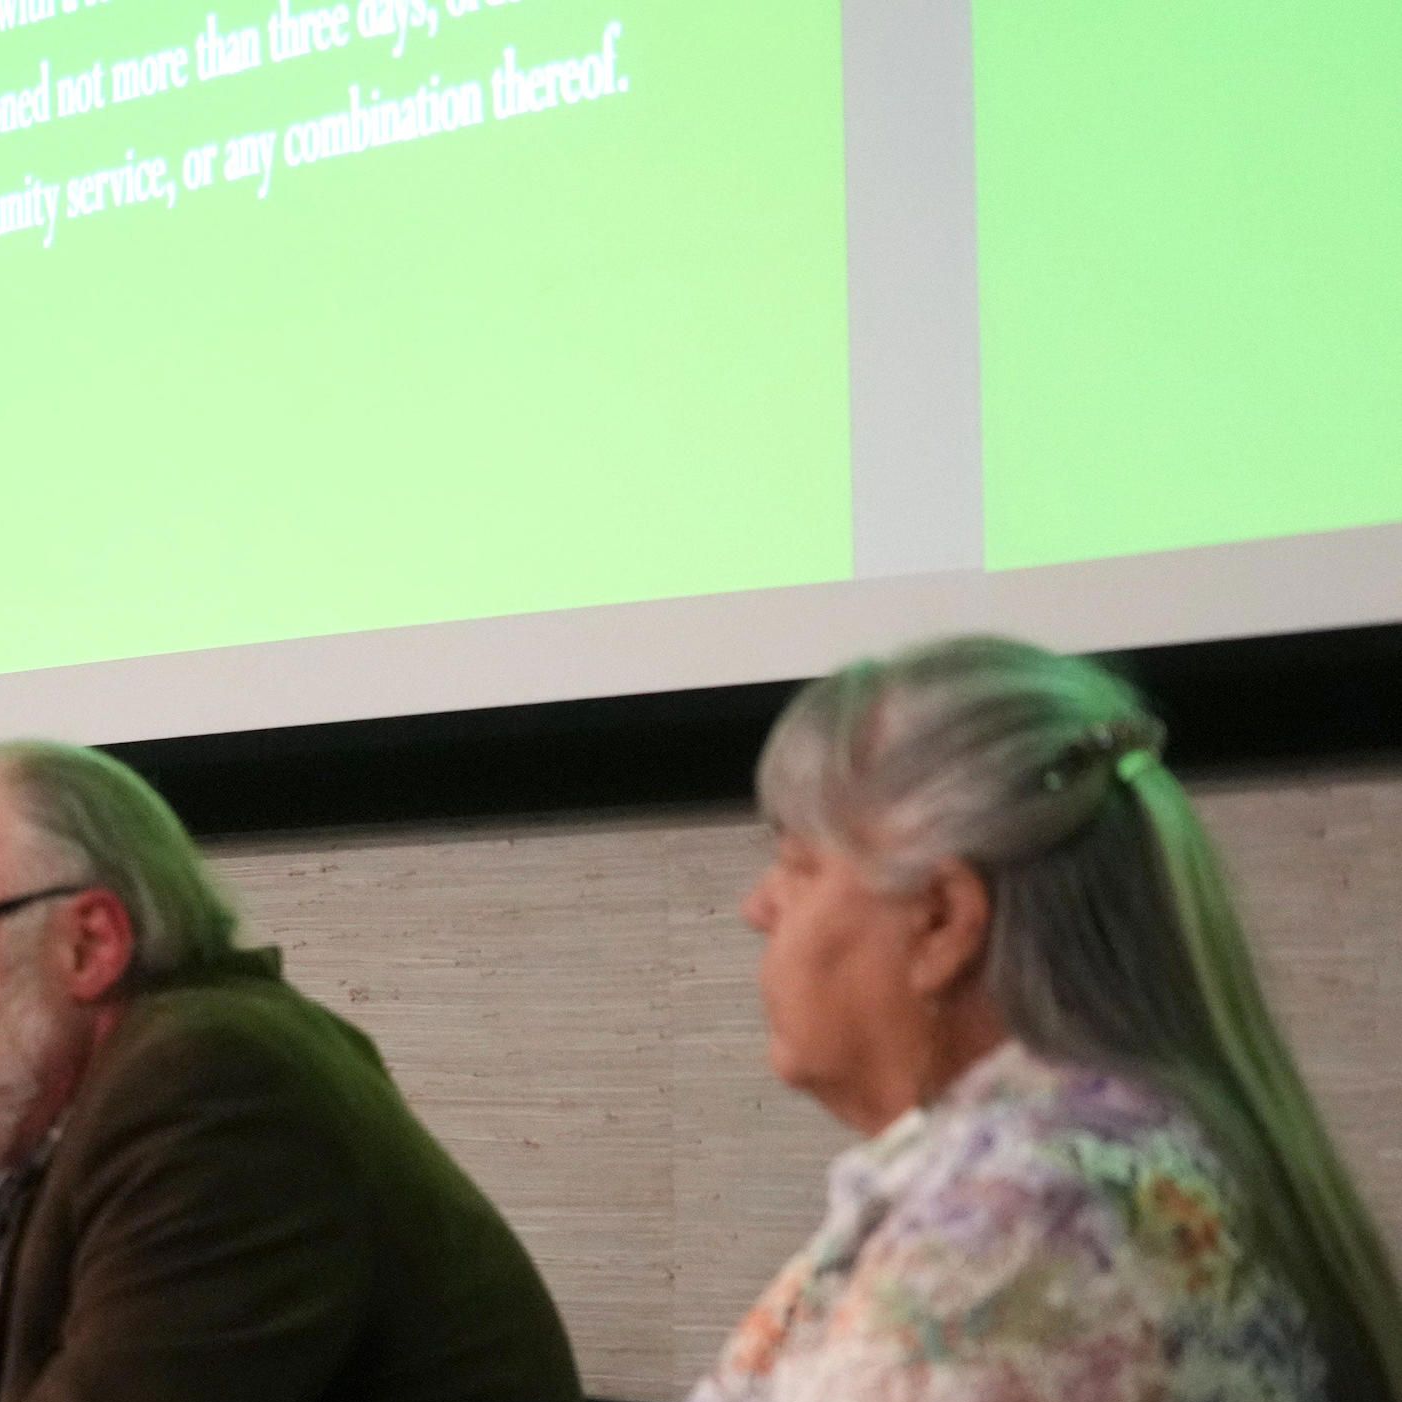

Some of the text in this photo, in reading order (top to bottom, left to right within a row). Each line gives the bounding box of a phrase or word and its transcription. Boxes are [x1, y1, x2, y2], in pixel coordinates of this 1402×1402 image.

[57, 61, 107, 117] not
[112, 45, 189, 104] more
[195, 11, 262, 82] than
[267, 0, 350, 63] three
[356, 0, 440, 59] days,
[66, 146, 178, 209] service,
[182, 140, 219, 191] or
[223, 129, 277, 200] any
[282, 73, 484, 167] combination
[491, 18, 631, 120] thereof.
